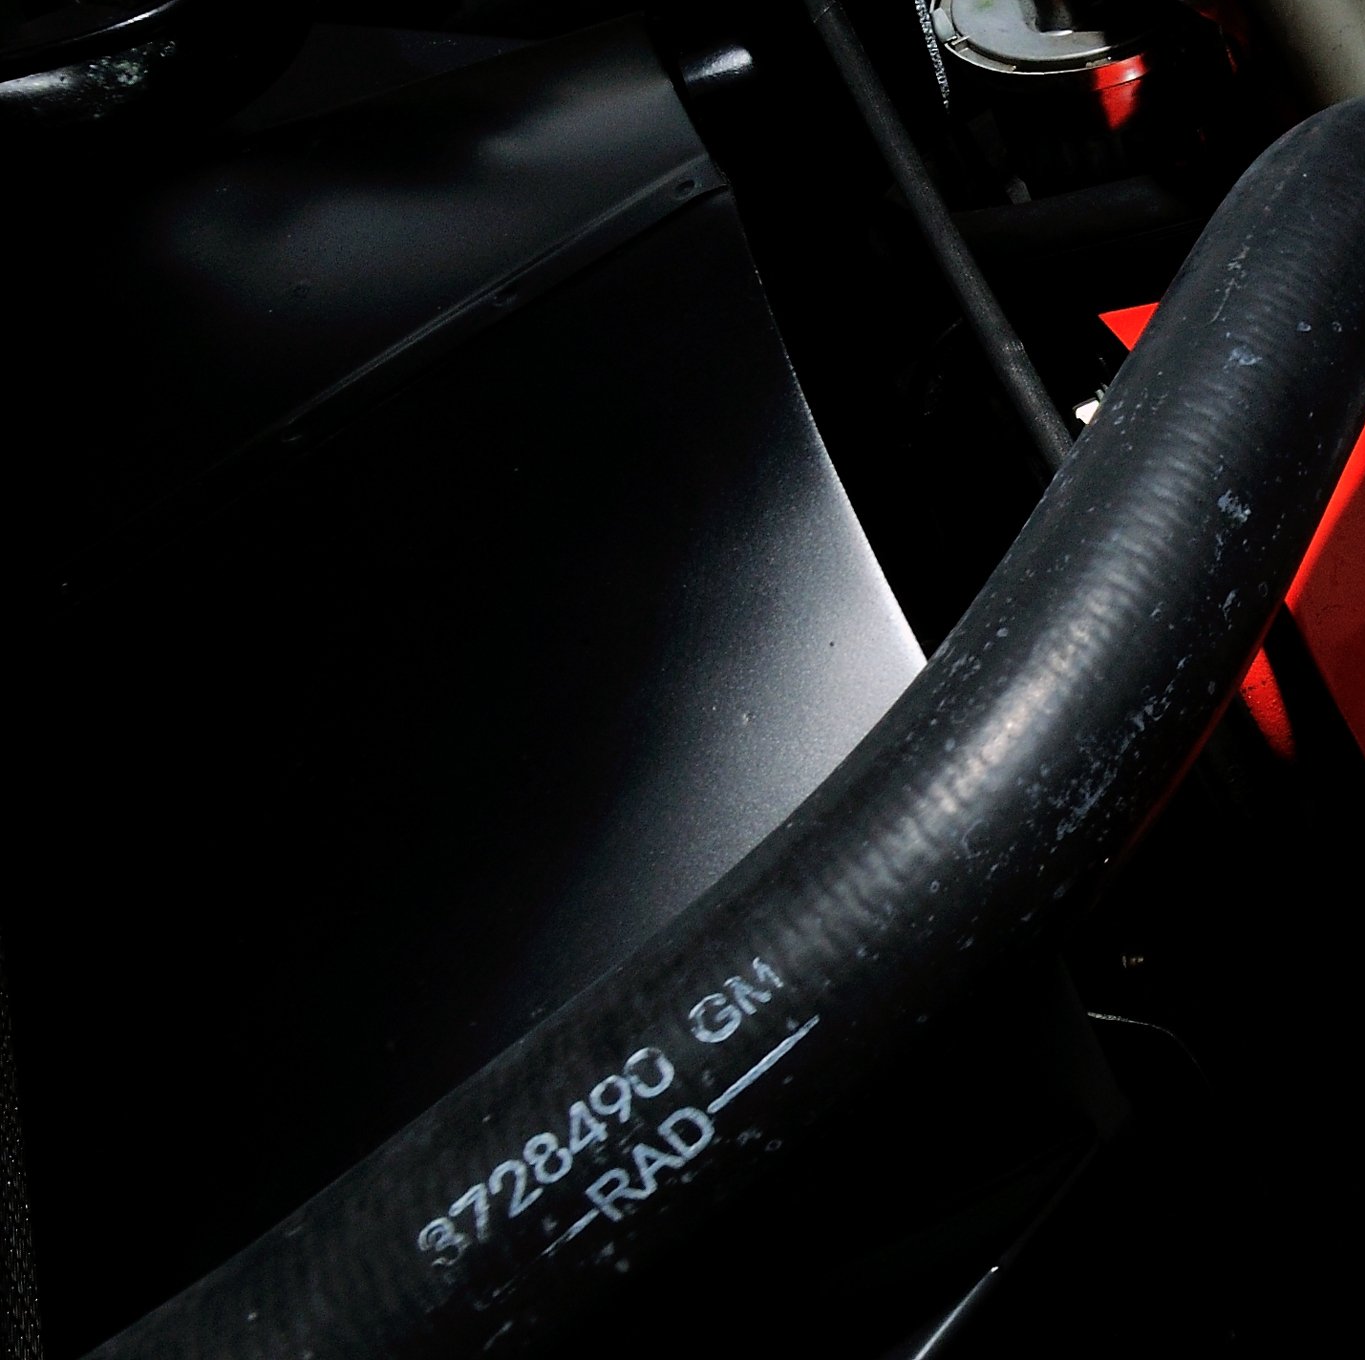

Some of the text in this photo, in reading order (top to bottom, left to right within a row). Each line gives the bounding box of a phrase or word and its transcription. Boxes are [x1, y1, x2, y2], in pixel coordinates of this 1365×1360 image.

[416, 955, 786, 1269] 3728490 GM
[584, 1104, 717, 1223] RAD
